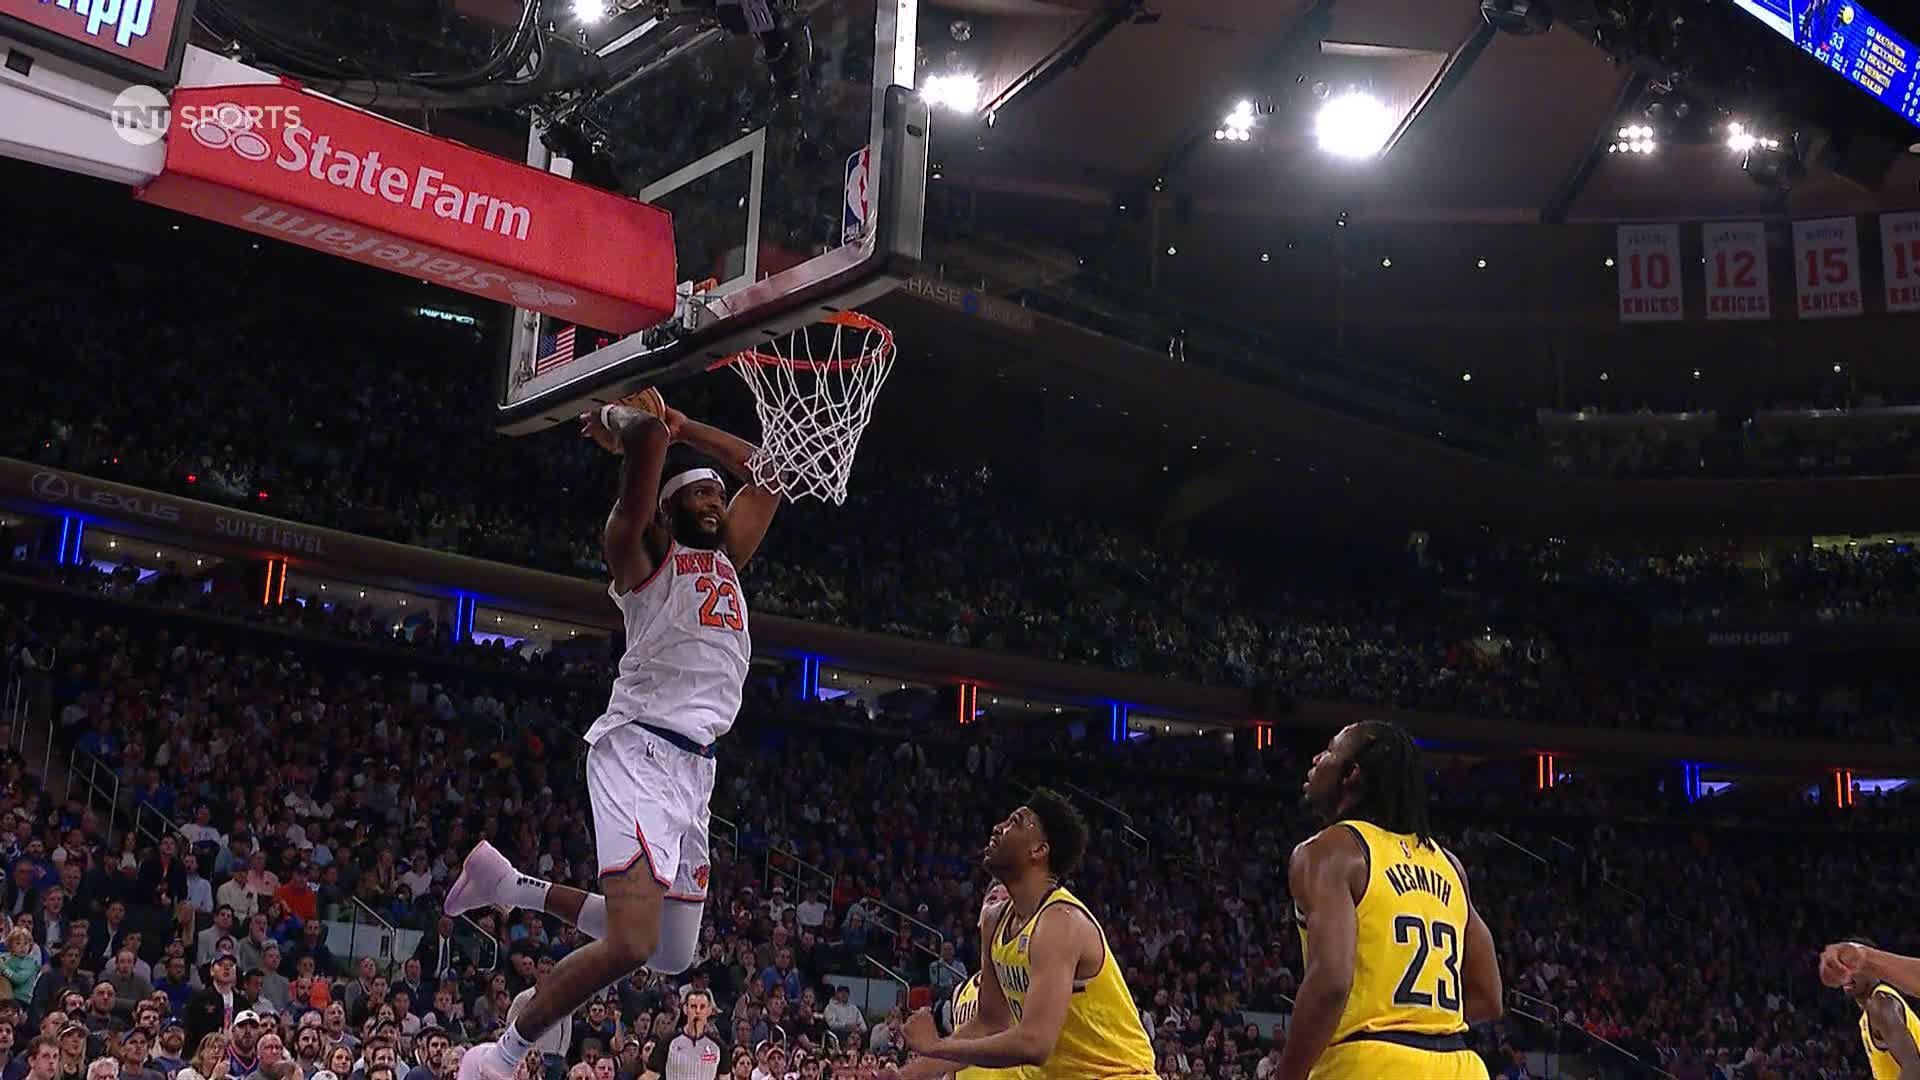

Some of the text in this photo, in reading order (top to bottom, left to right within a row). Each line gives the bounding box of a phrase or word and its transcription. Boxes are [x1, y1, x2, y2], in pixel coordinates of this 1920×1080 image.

[1629, 253, 1670, 289] 10
[1714, 250, 1757, 288] 12
[1805, 247, 1849, 287] 15
[1623, 296, 1680, 314] KNICKS
[1710, 296, 1767, 313] KNICKS
[1801, 291, 1858, 311] KNICKS
[72, 485, 182, 522] LEXUS
[215, 517, 327, 554] SUITE LEVEL
[675, 552, 715, 576] NEW
[695, 576, 744, 631] 23
[1385, 863, 1451, 907] NESMITH
[1393, 915, 1461, 1012] 23
